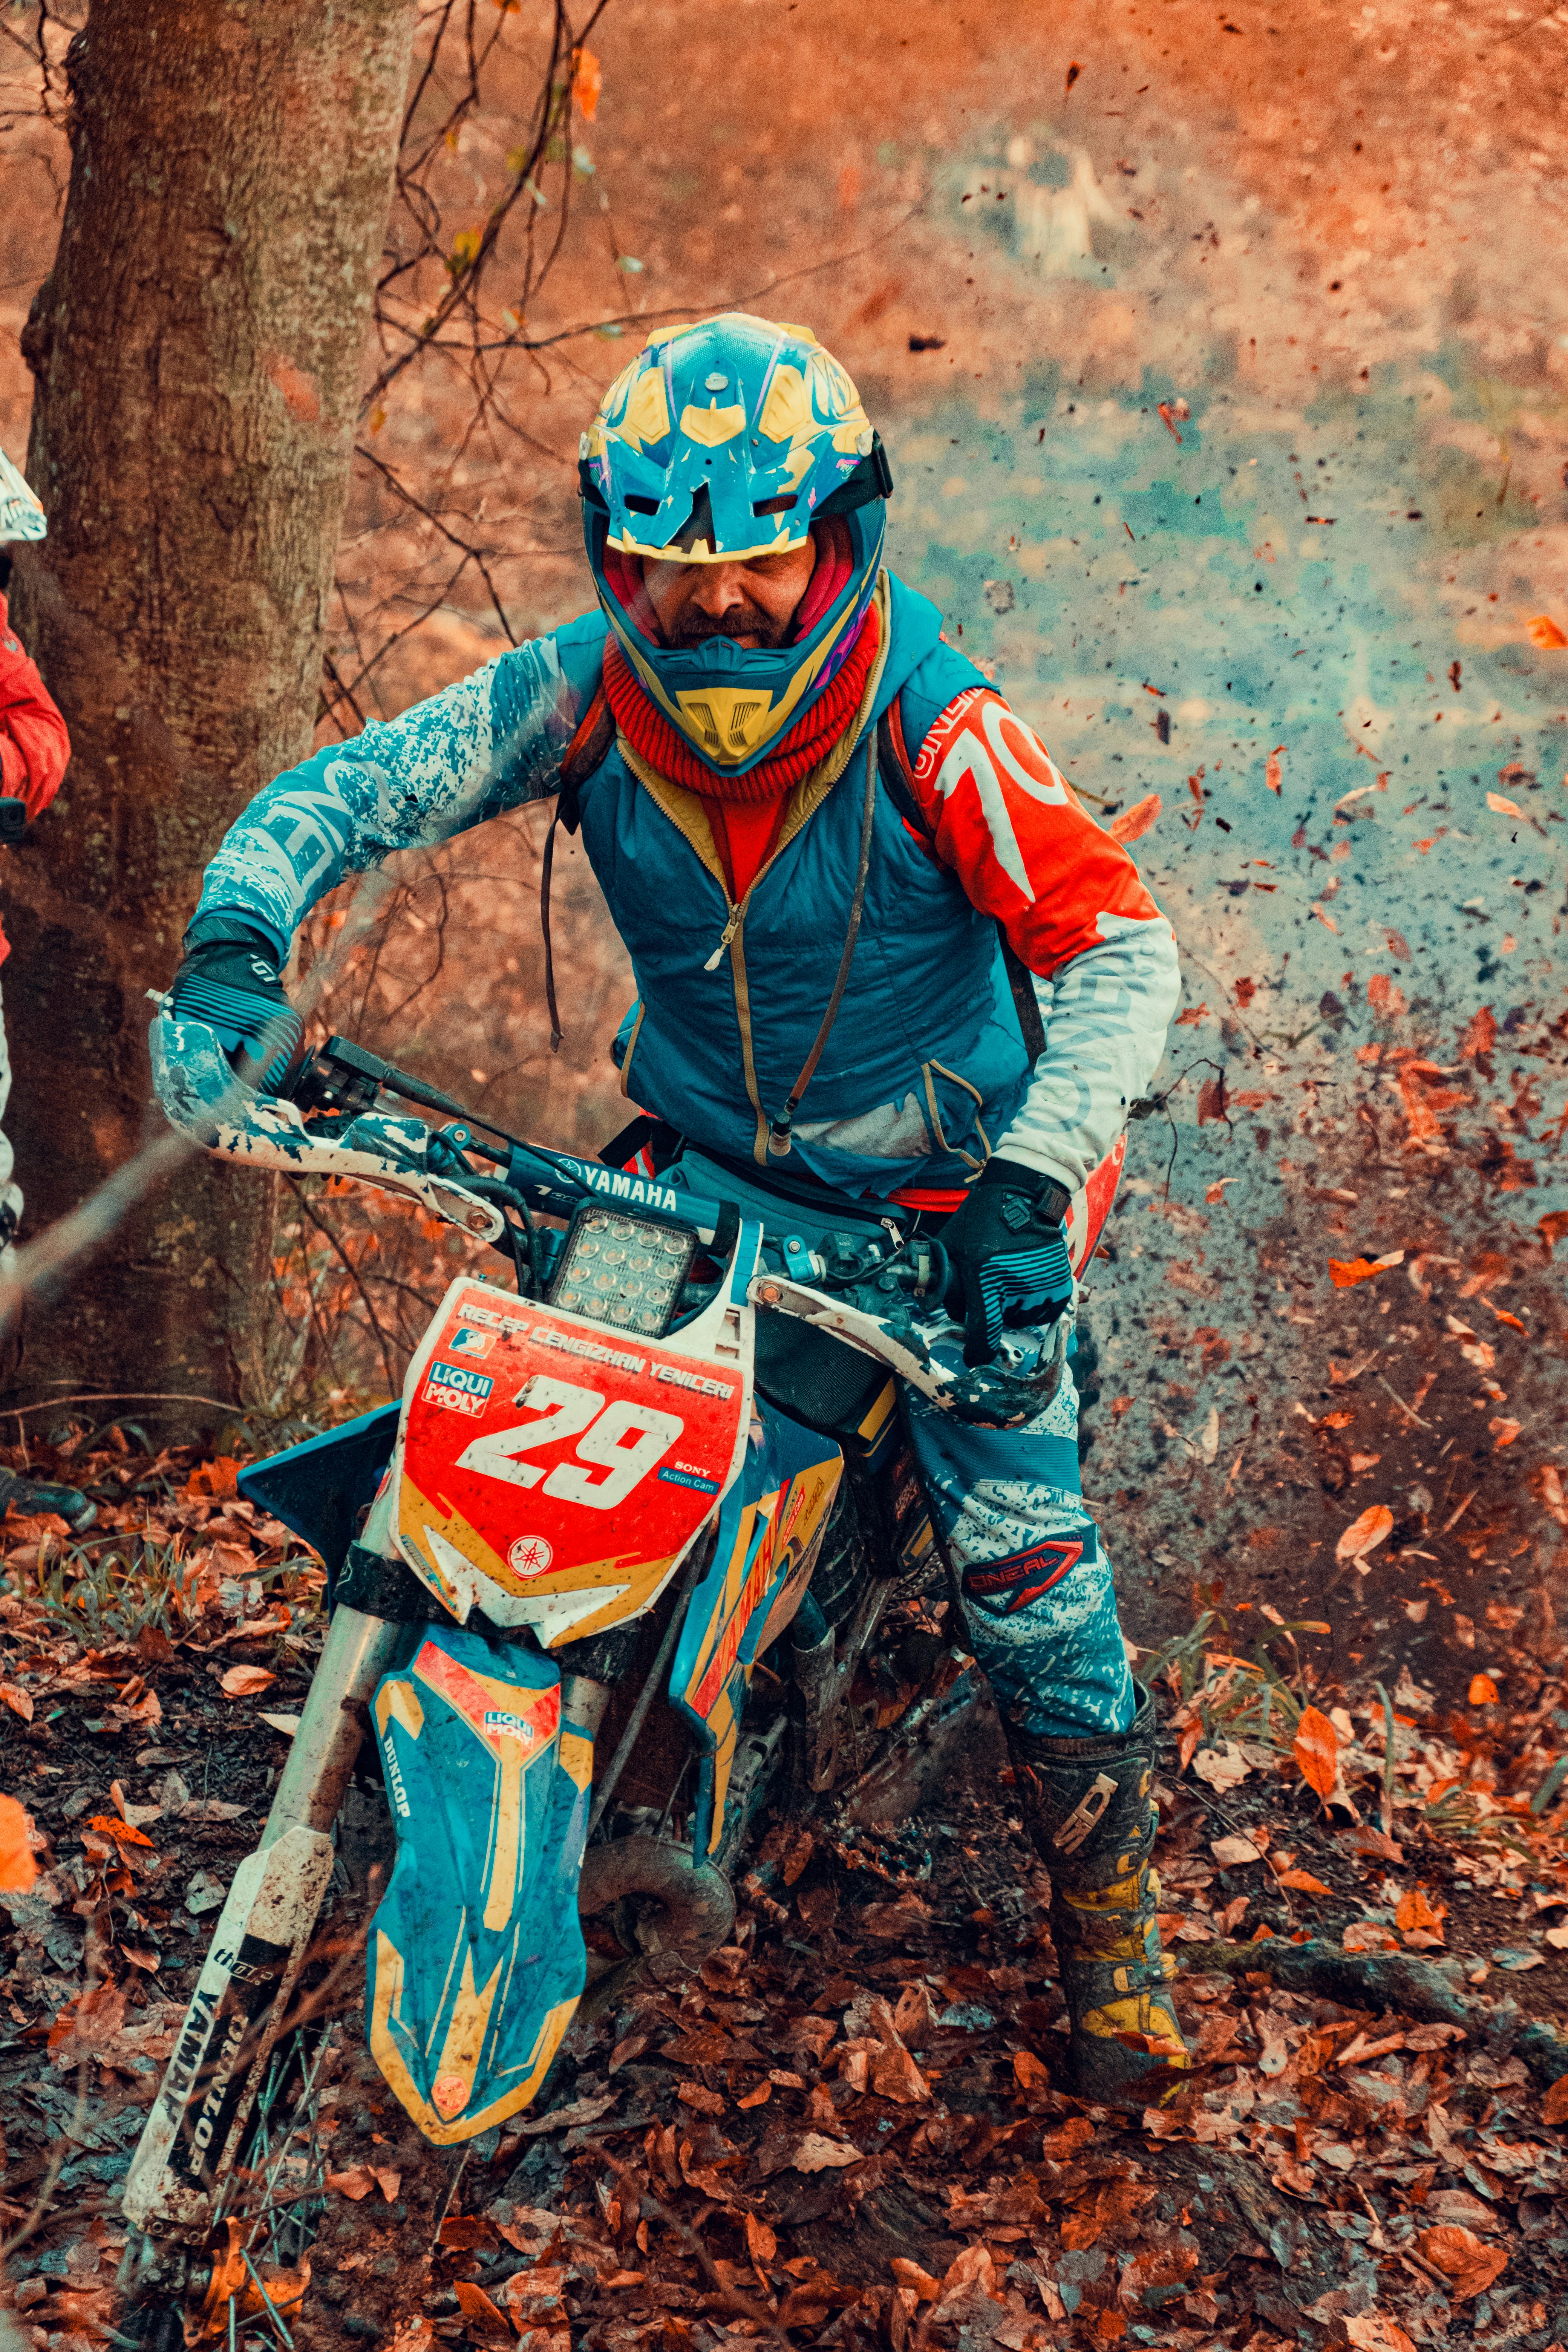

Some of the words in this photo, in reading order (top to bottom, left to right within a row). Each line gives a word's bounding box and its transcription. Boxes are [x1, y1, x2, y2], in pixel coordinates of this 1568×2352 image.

[584, 1165, 676, 1211] YAMAHA
[457, 1303, 529, 1333] RECEP
[432, 1364, 490, 1396] LIQUI
[426, 1383, 485, 1413] MOLY
[455, 1374, 684, 1510] 29
[662, 1470, 692, 1485] Action
[694, 1479, 714, 1492] Cam
[675, 1461, 711, 1477] SONY
[487, 1724, 532, 1746] MOLY
[488, 1713, 531, 1736] LIQUI
[384, 1735, 411, 1818] DUNLOP
[163, 1989, 219, 2127] YAMAH
